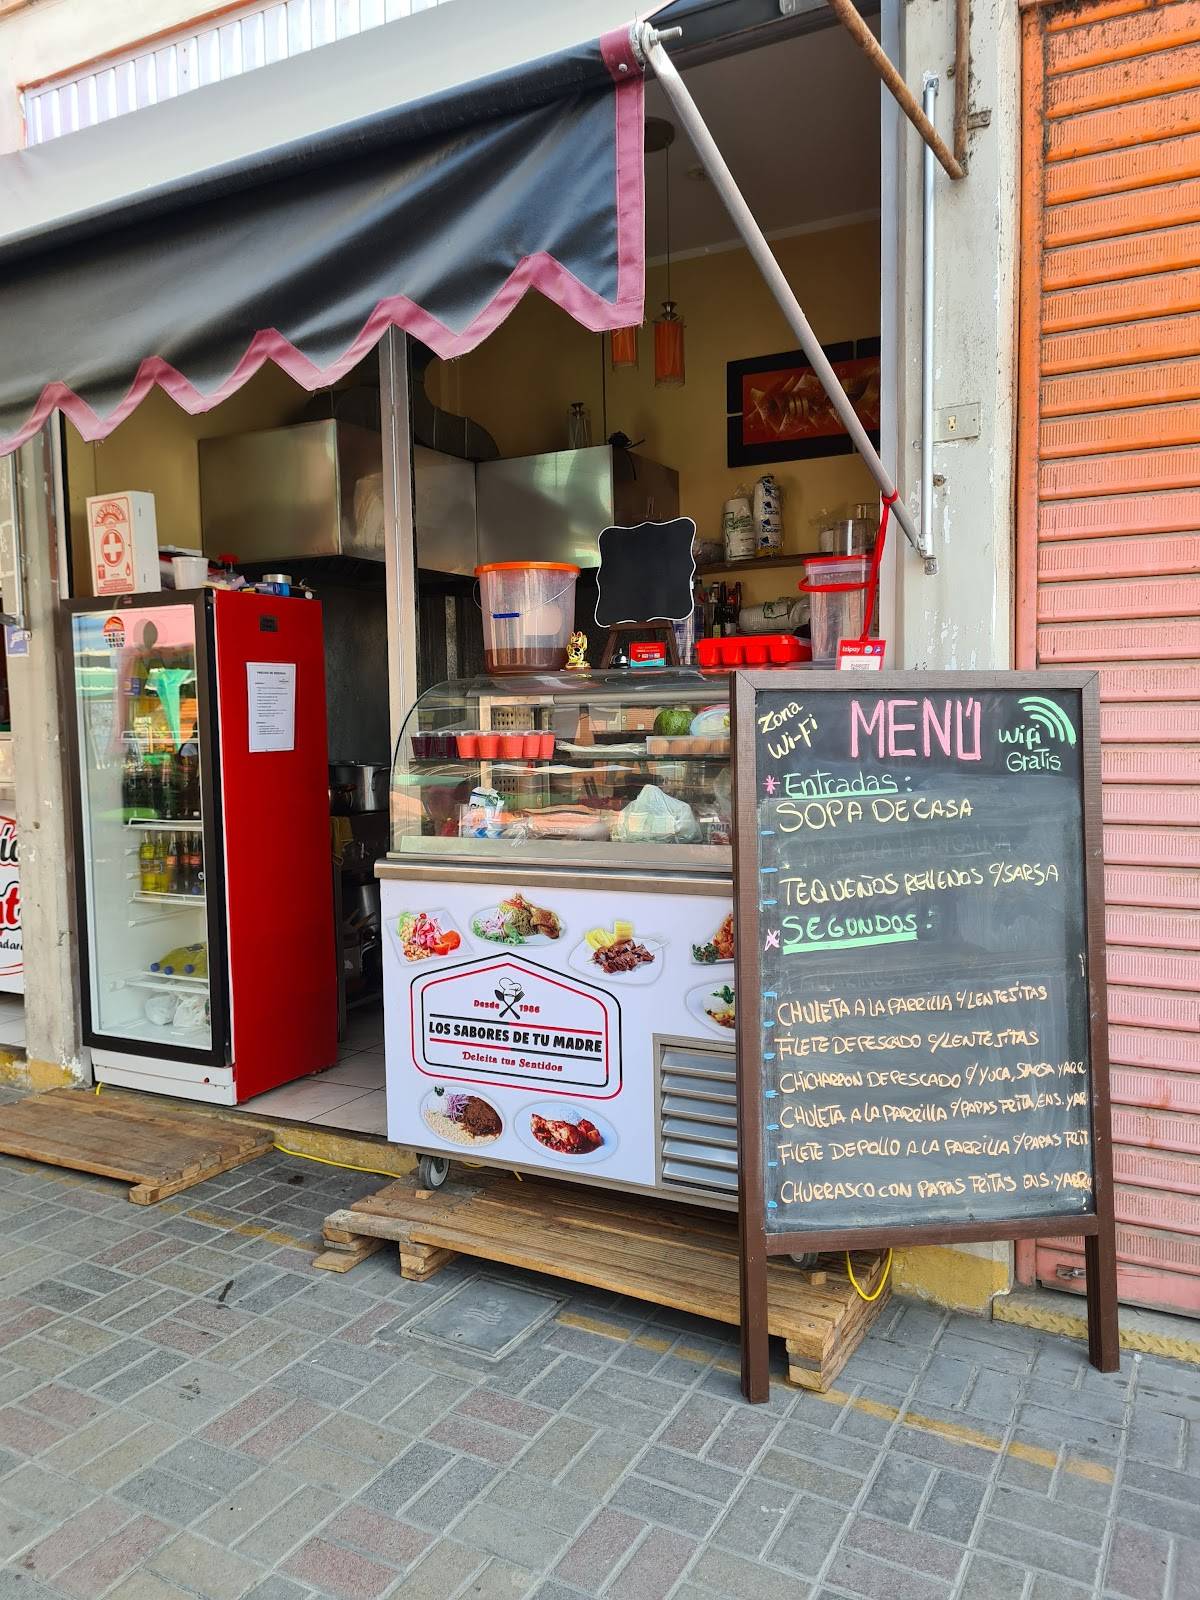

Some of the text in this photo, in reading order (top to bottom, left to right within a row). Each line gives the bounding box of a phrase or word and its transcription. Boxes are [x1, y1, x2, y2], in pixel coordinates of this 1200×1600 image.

[758, 701, 803, 734] Zona
[851, 697, 981, 760] MENÚ
[767, 713, 819, 759] Wi-Fi
[775, 799, 863, 832] SOPA
[916, 798, 974, 819] CASA
[779, 873, 899, 906] TEQUEÑOS
[473, 999, 541, 1014] Desde 1986
[777, 998, 850, 1026] CHULETA
[429, 1021, 602, 1053] LOS SABORES DE TU MADRE
[462, 1051, 563, 1073] Deleita tus Sentidos
[780, 1104, 847, 1128] CHULETA
[778, 1140, 824, 1166] FILETE
[781, 1181, 875, 1204] CHURRASCO
[879, 1182, 912, 1198] CON
[917, 1178, 967, 1198] PAPAS
